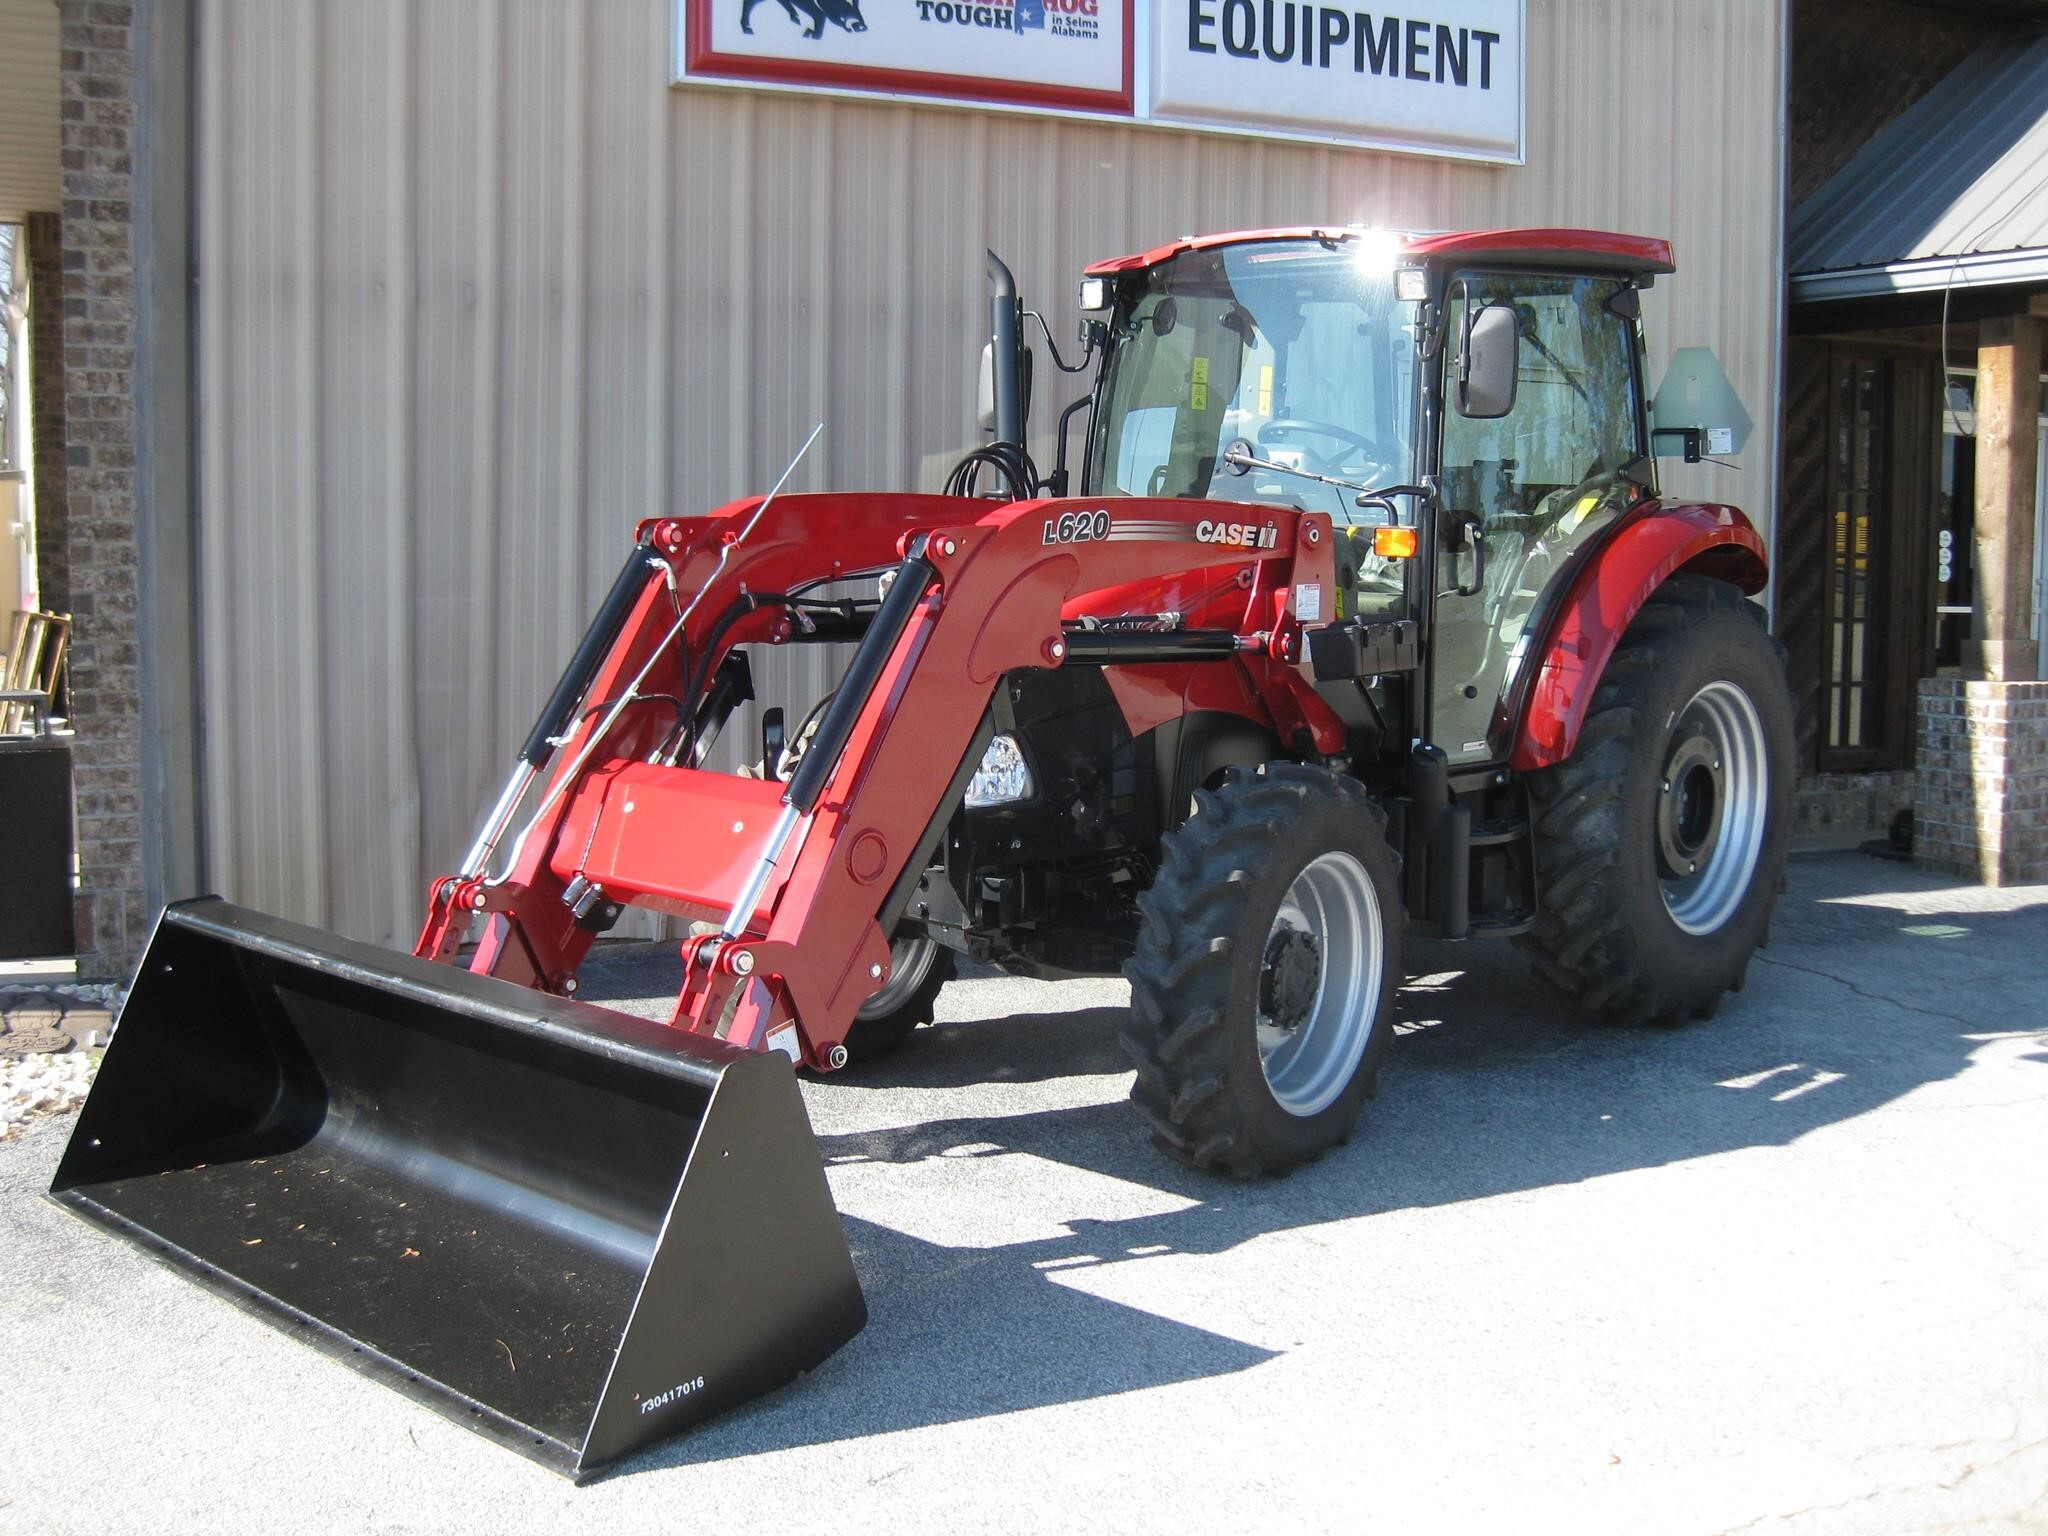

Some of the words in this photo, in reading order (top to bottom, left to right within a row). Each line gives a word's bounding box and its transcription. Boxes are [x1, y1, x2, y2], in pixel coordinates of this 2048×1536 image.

[916, 1, 1013, 30] TOUGH
[1052, 14, 1062, 25] in
[1065, 16, 1098, 28] Selma
[1051, 26, 1098, 39] Alabama
[1189, 0, 1500, 90] EQUIPMENT
[1042, 510, 1110, 545] L620
[1196, 520, 1257, 546] CASE
[641, 1376, 705, 1414] 730417016
